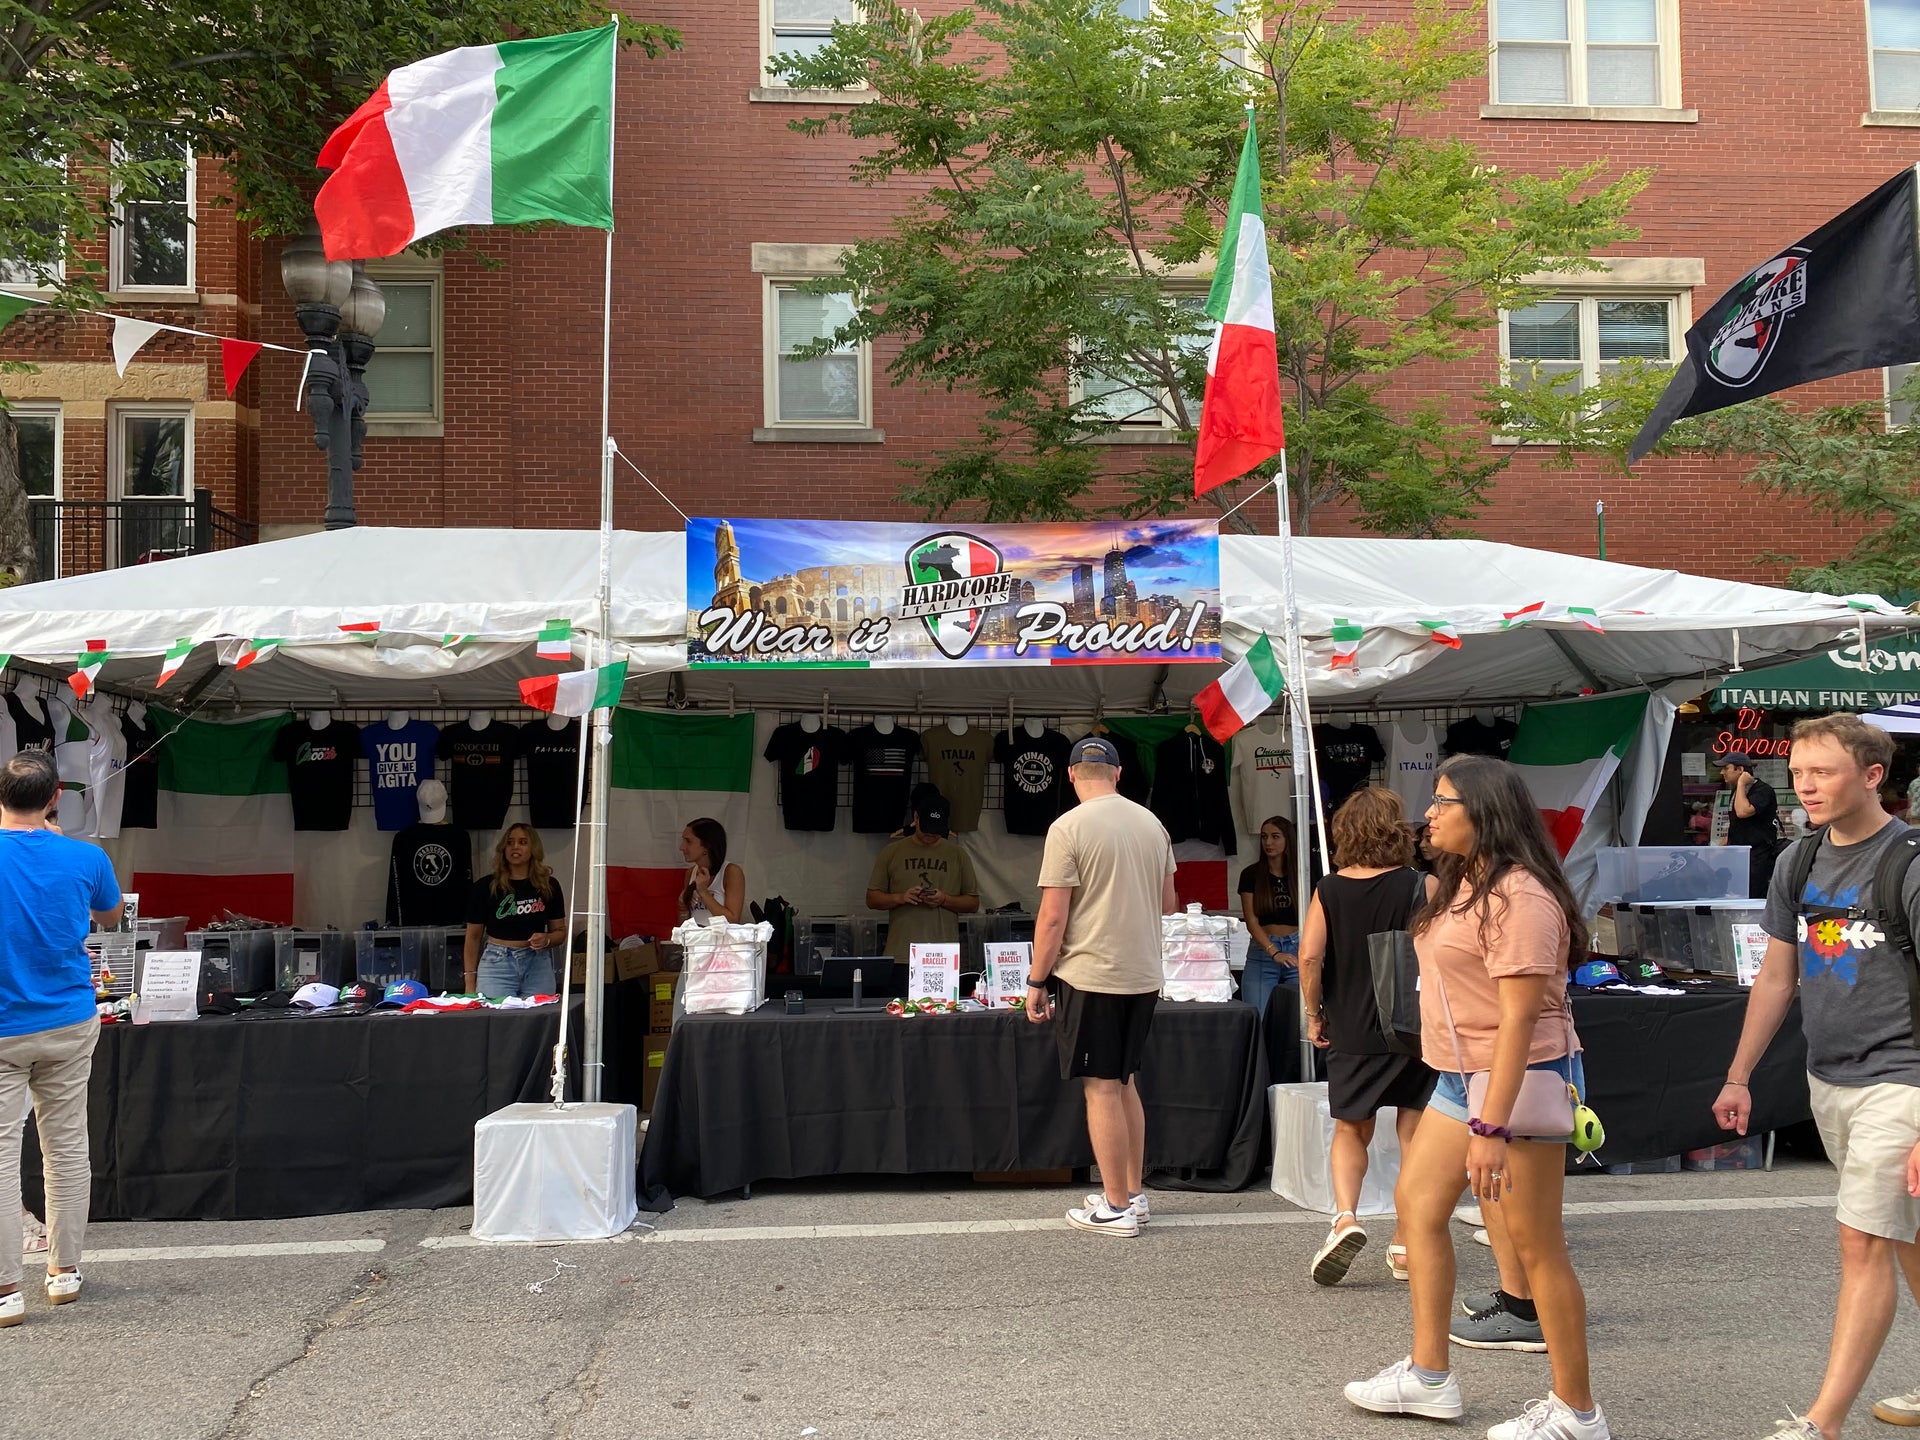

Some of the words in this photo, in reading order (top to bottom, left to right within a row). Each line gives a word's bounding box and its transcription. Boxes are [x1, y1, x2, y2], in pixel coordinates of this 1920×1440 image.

[902, 574, 1011, 606] HARDCORE
[902, 592, 1007, 617] ITALIANS
[699, 606, 833, 653] Wear
[848, 617, 891, 653] it
[1015, 600, 1206, 655] Proud!
[1720, 688, 1810, 706] ITALIAN
[1819, 691, 1868, 706] FINE
[1876, 692, 1920, 706] WIN
[1738, 708, 1765, 730] Di
[375, 743, 416, 761] YOU
[453, 743, 500, 752] GNOCCHI
[534, 746, 577, 754] PAISANS
[1255, 746, 1291, 757] Chicago
[1712, 731, 1791, 756] Savoia
[941, 749, 976, 761] ITALIA
[1013, 751, 1054, 772] STUNADS
[378, 763, 399, 772] GIVE
[402, 762, 414, 772] ME
[1399, 762, 1433, 771] ITALIA
[377, 773, 417, 789] AGITA
[1013, 773, 1053, 793] STUNADS
[904, 857, 948, 873] ITALIA
[495, 893, 546, 920] Chooch
[921, 957, 947, 965] BRACELET
[997, 955, 1022, 964] BRACELET
